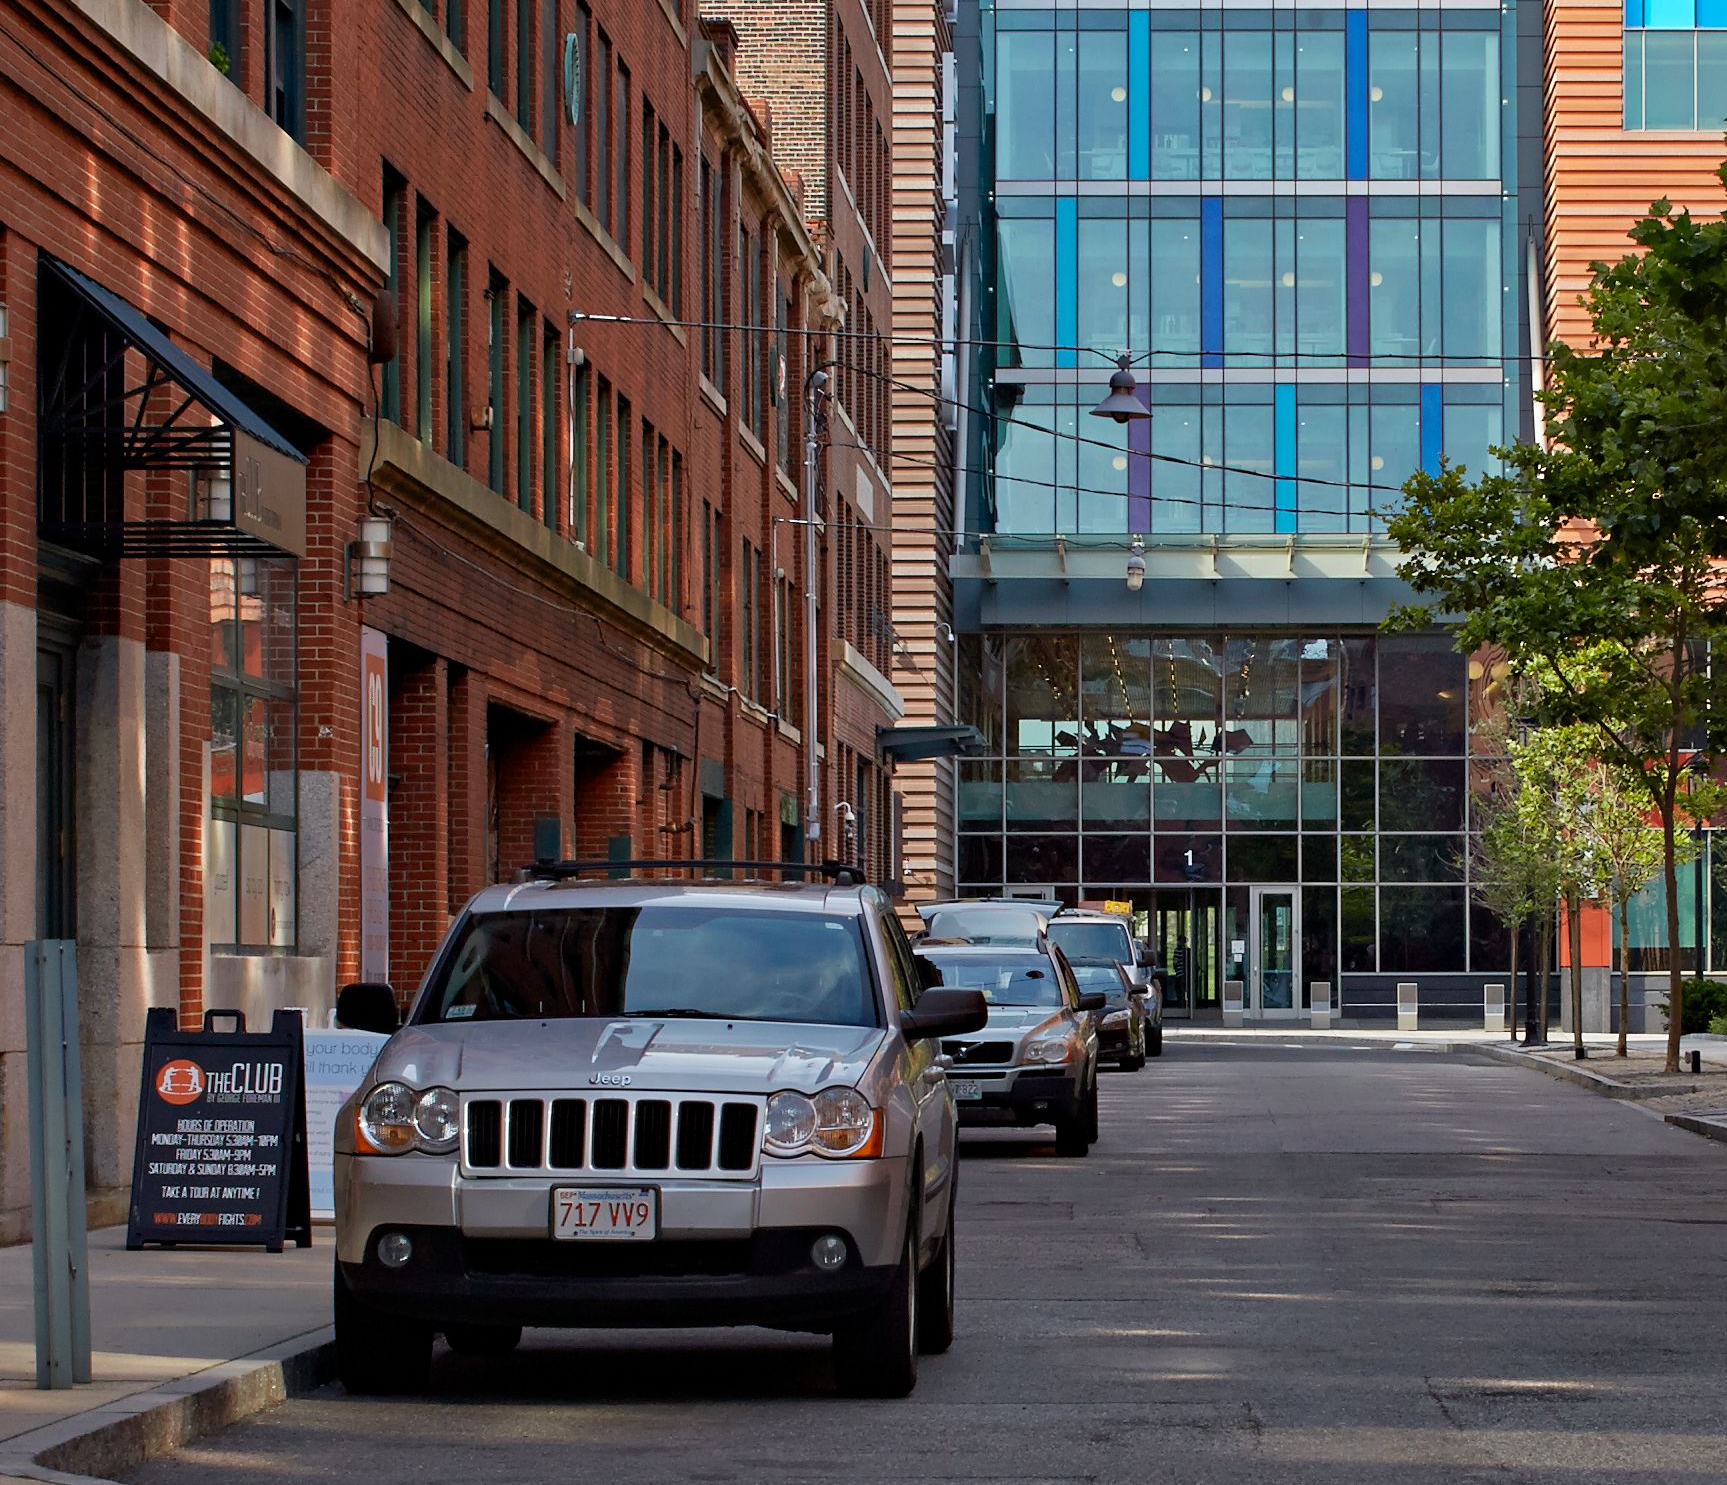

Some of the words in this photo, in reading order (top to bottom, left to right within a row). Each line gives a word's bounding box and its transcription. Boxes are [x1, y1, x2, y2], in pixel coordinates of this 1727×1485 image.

[1183, 849, 1193, 866] 1
[306, 1043, 336, 1057] your
[342, 1042, 378, 1058] body
[318, 1061, 357, 1074] thank
[589, 1072, 632, 1087] Jeep
[206, 1094, 215, 1103] BY
[217, 1094, 241, 1103] GEORGE
[242, 1094, 273, 1103] FOREMAN
[177, 1119, 202, 1132] HOURS
[203, 1119, 214, 1132] OF
[214, 1119, 255, 1132] OPERATION
[175, 1148, 201, 1160] FRIDAY
[148, 1162, 188, 1174] SATURDAY
[188, 1163, 196, 1175] &
[197, 1163, 226, 1175] SUNDAY
[161, 1185, 181, 1198] TAKE
[181, 1186, 188, 1198] A
[189, 1186, 209, 1199] TOUR
[209, 1186, 221, 1199] AT
[560, 1202, 601, 1227] 717
[608, 1202, 649, 1227] VV9
